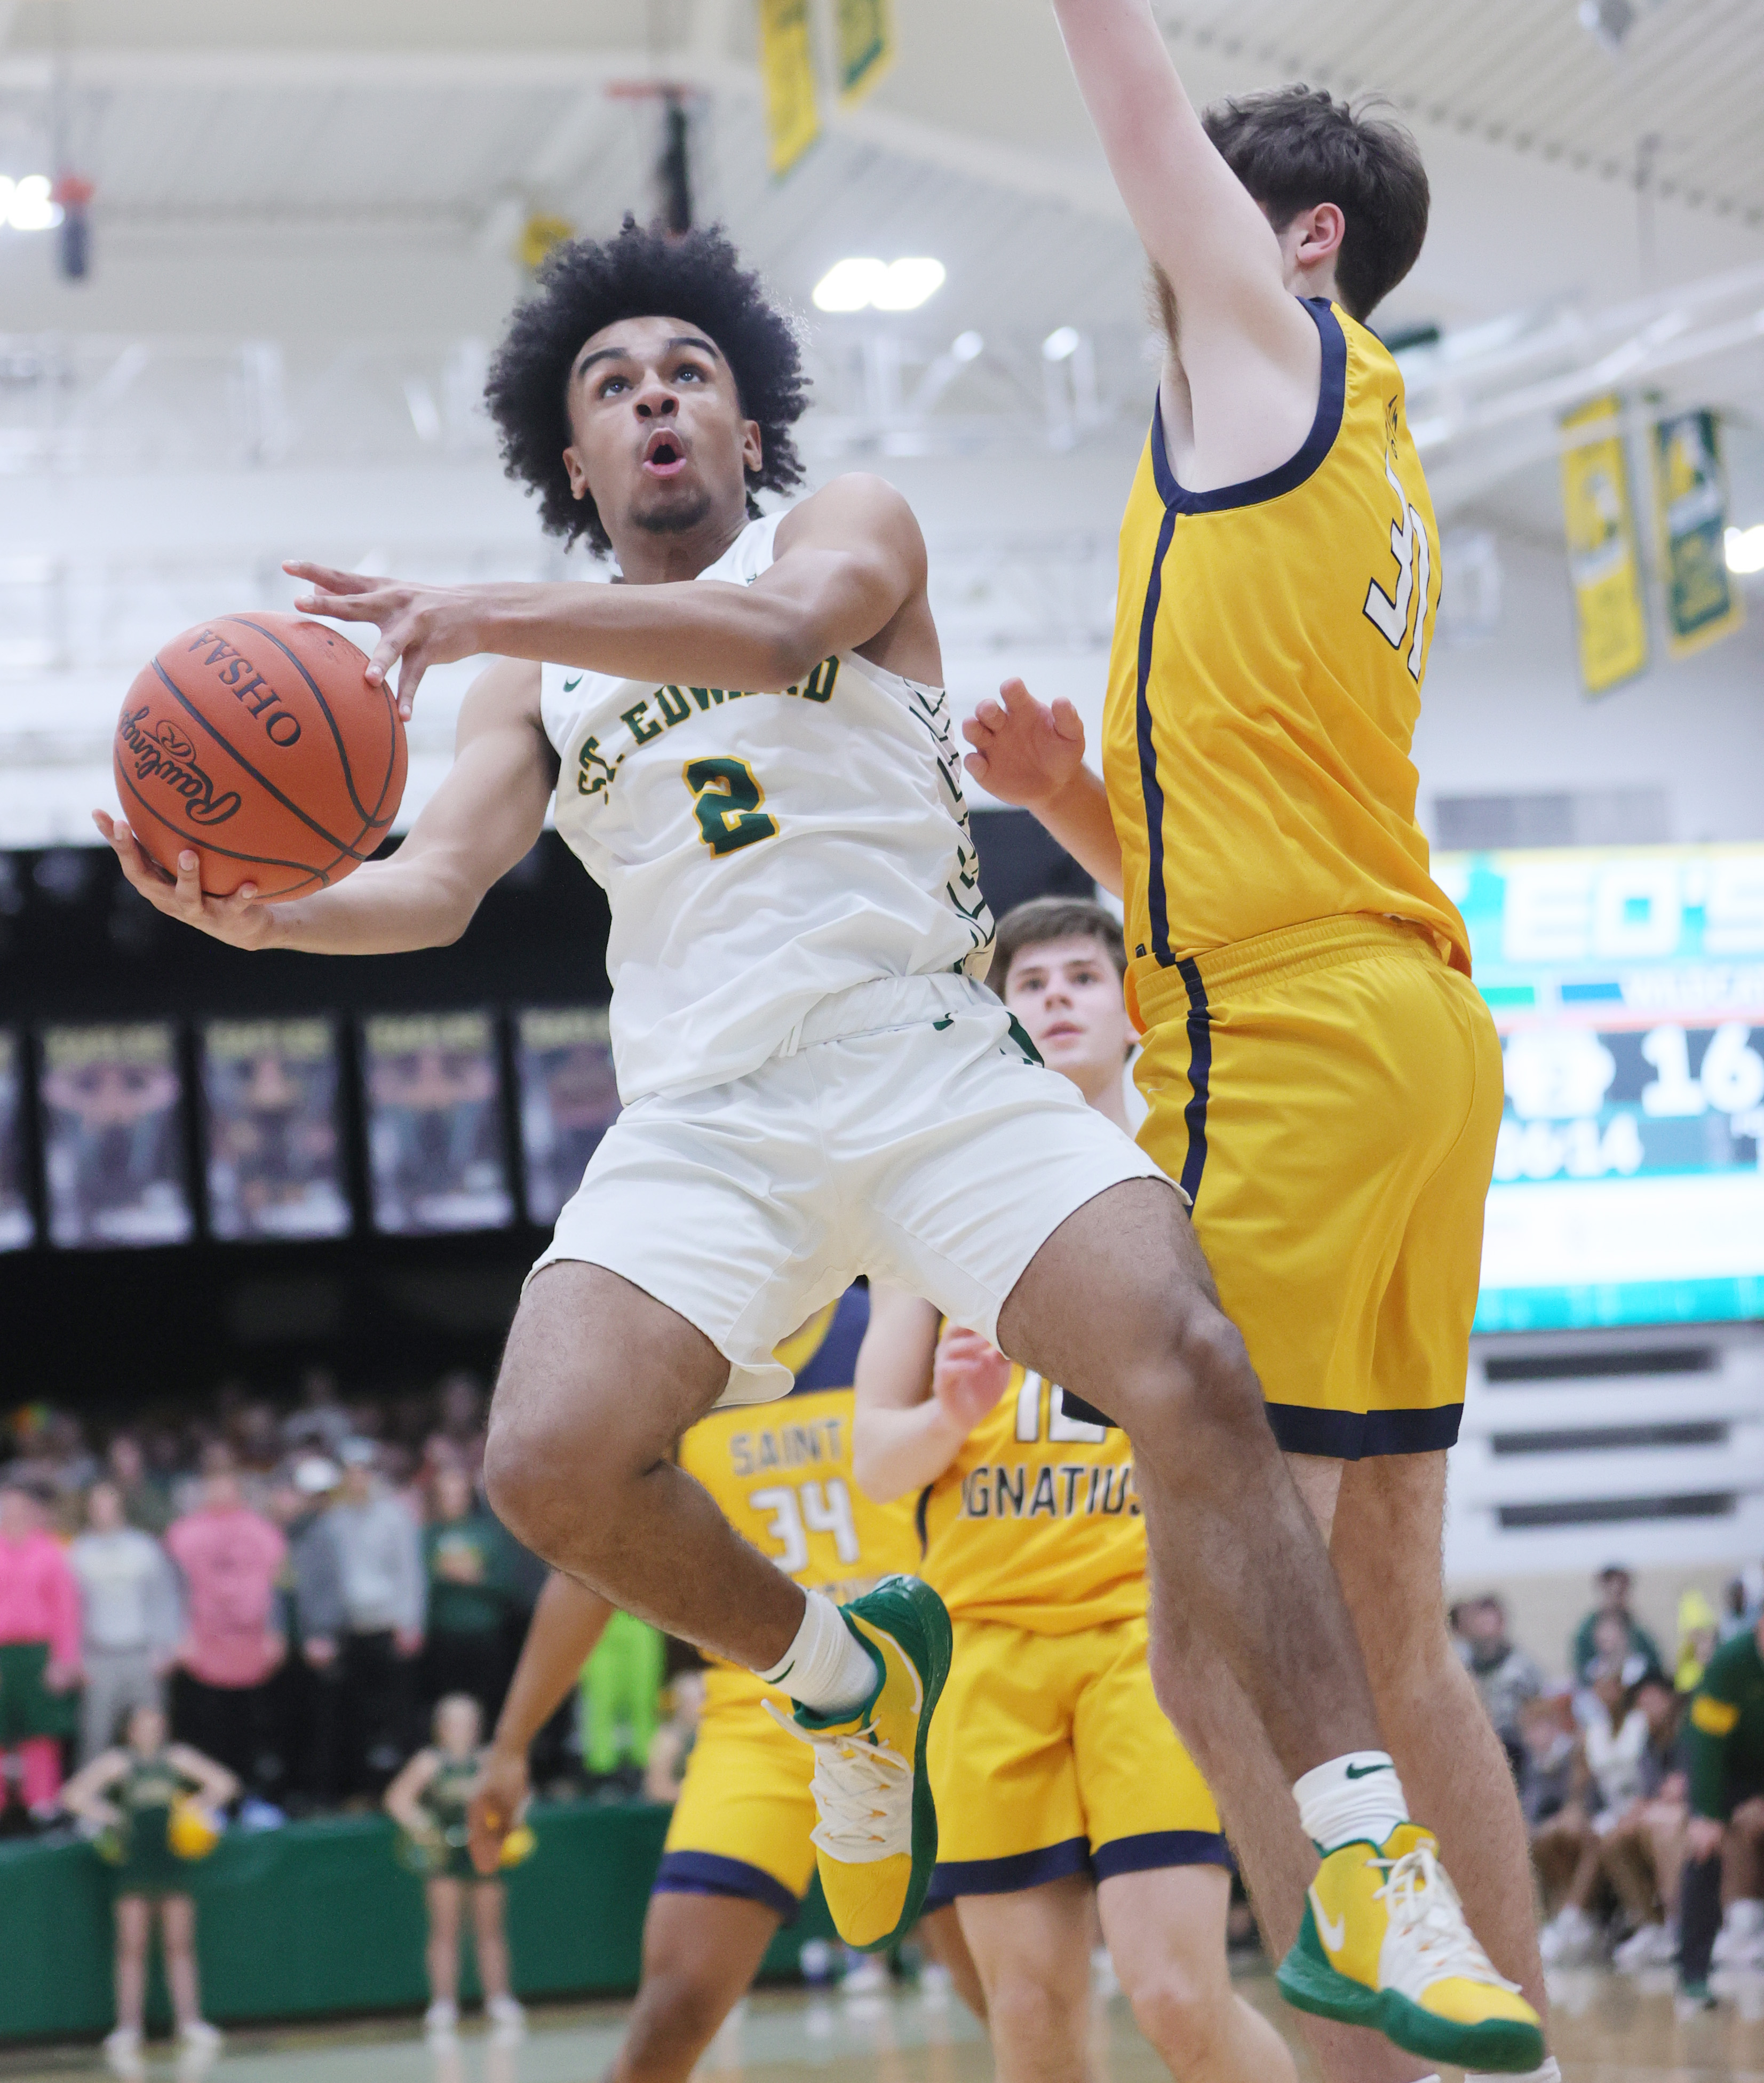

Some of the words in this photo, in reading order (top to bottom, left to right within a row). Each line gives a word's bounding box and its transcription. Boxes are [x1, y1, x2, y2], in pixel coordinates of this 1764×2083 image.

[188, 630, 301, 748] OHSAA
[577, 735, 625, 806] ST.
[619, 654, 840, 746] EDWD
[120, 705, 242, 826] Rawlings
[681, 754, 781, 861] 2
[729, 1418, 843, 1478] SAINT
[957, 1463, 1141, 1520] GNATIU
[748, 1476, 860, 1575] 34
